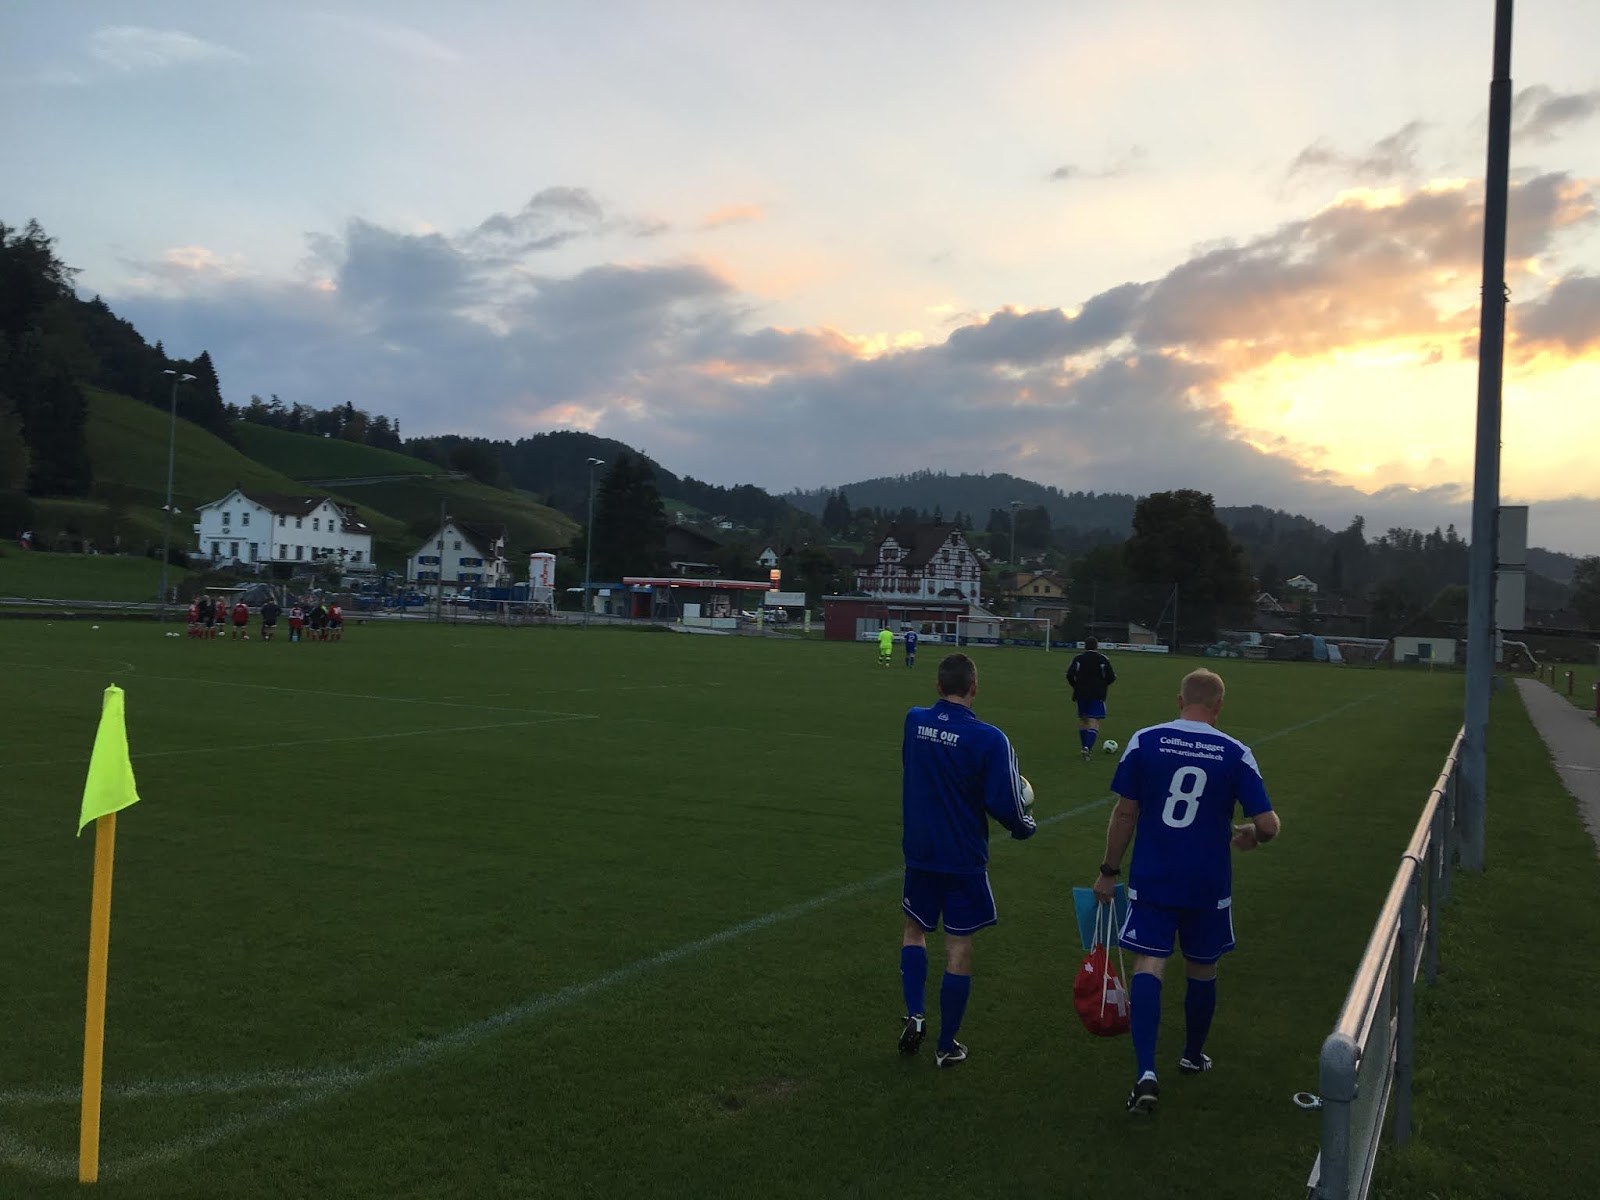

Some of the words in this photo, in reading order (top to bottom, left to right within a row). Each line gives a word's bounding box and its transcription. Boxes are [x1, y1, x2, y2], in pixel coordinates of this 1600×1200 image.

[917, 725, 939, 738] TIME
[940, 731, 960, 743] OUT
[1160, 736, 1194, 748] Coiffure
[1162, 766, 1207, 828] 8
